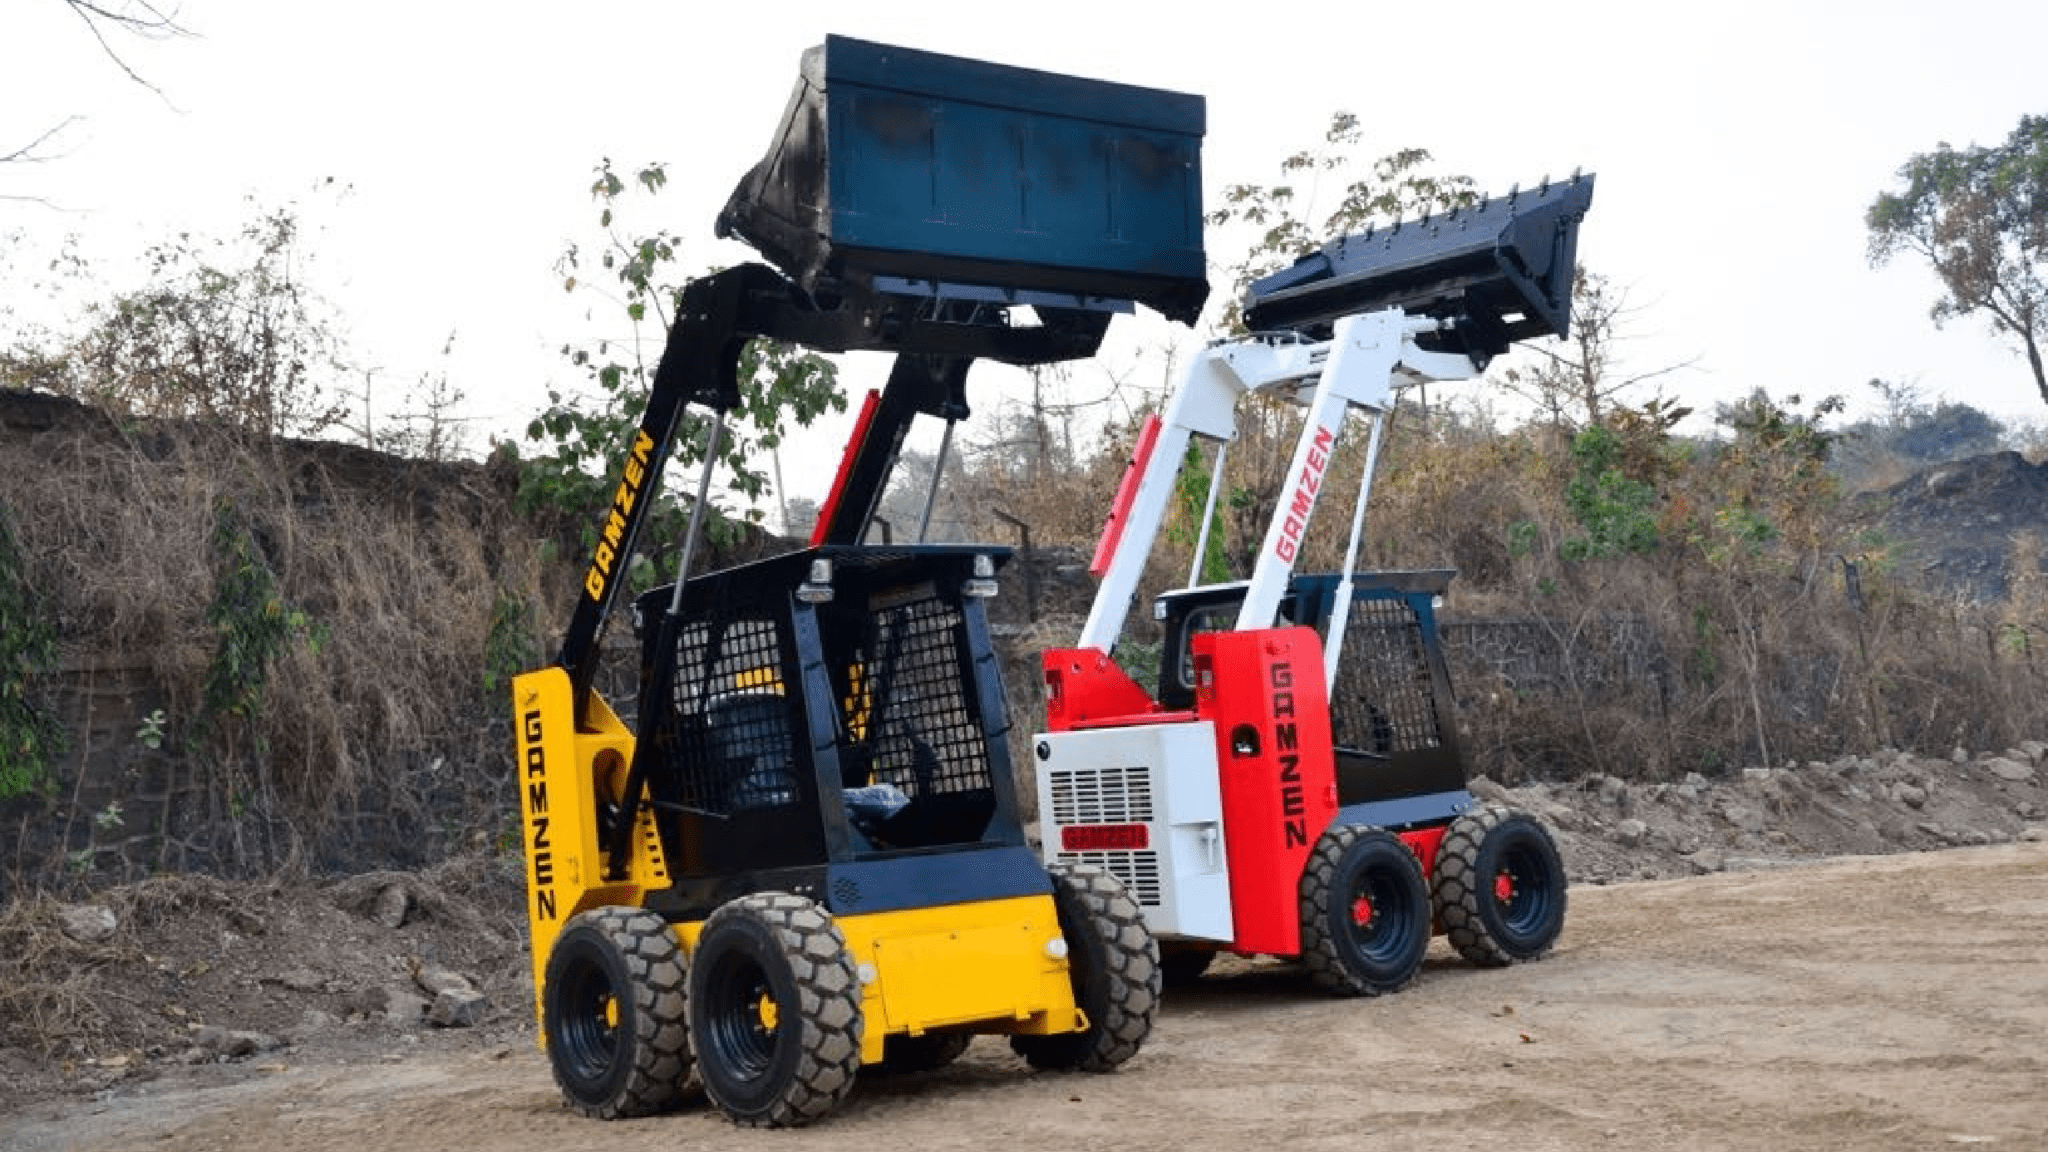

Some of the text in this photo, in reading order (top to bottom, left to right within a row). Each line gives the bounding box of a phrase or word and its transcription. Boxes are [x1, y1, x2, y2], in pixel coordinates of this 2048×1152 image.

[585, 428, 654, 601] GAMZEN
[1275, 425, 1333, 563] GAMZEN
[525, 708, 556, 920] GAMZEN
[1270, 662, 1307, 849] GAMZEN
